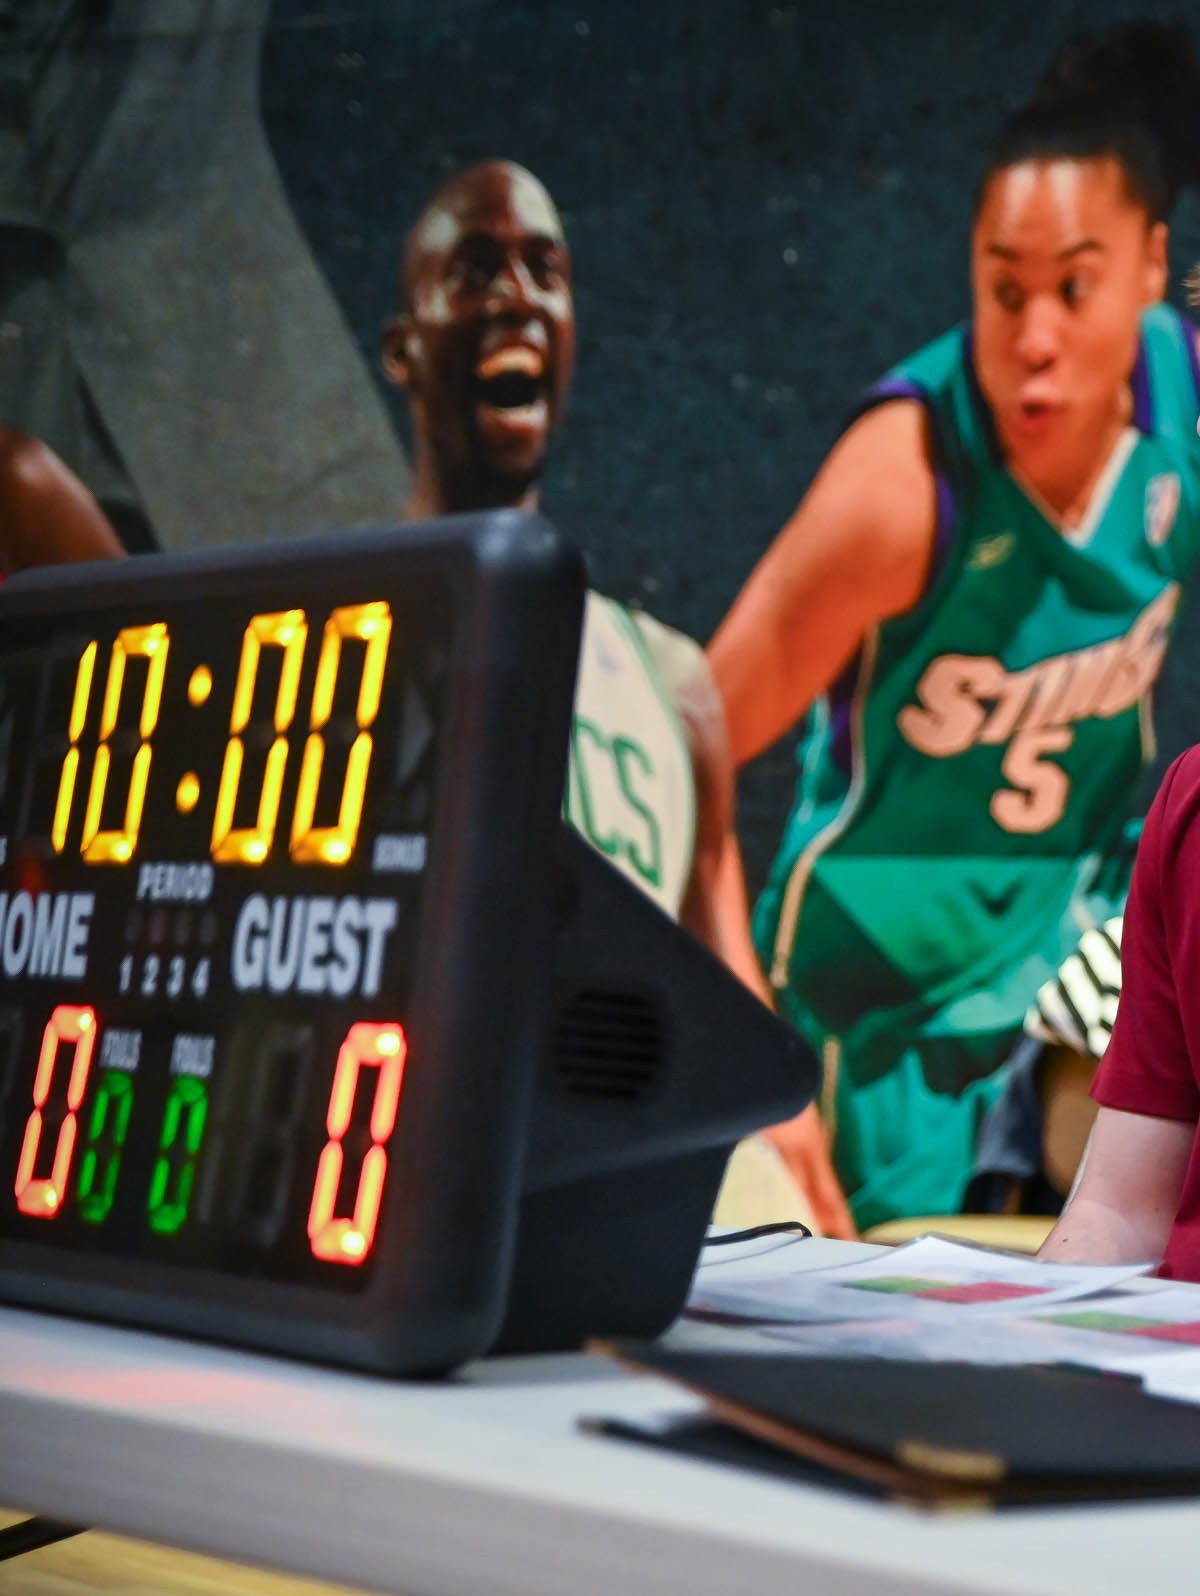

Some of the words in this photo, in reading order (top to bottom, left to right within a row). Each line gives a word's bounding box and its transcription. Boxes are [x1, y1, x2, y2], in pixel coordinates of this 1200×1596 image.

[51, 601, 393, 866] 10:00
[562, 712, 663, 888] CS
[989, 724, 1075, 834] 5
[137, 862, 214, 901] PERIOD
[231, 893, 398, 997] GUEST
[118, 955, 134, 994] 1
[141, 957, 161, 995] 2
[166, 957, 186, 997] 3
[191, 957, 211, 998] 4
[14, 1003, 97, 1219] 0
[78, 1068, 134, 1224] 0
[148, 1074, 208, 1236] 0
[306, 1022, 408, 1266] 0
